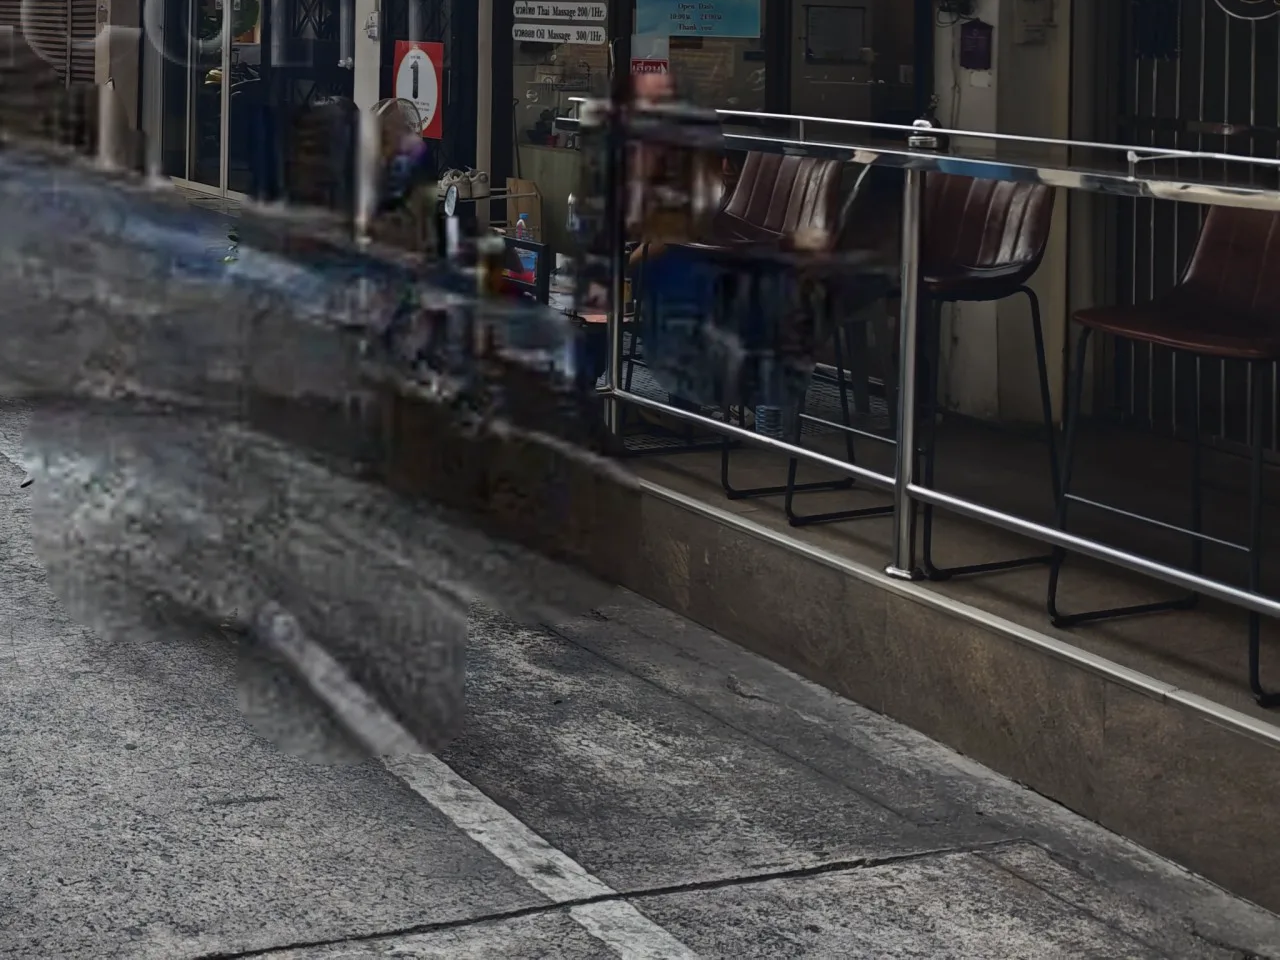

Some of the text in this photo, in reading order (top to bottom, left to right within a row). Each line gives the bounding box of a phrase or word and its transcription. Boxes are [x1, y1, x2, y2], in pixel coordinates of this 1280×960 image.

[537, 5, 549, 15] Thai
[552, 6, 576, 20] Massage
[536, 28, 545, 38] Oil
[547, 29, 571, 43] Massage
[410, 60, 418, 99] 1
